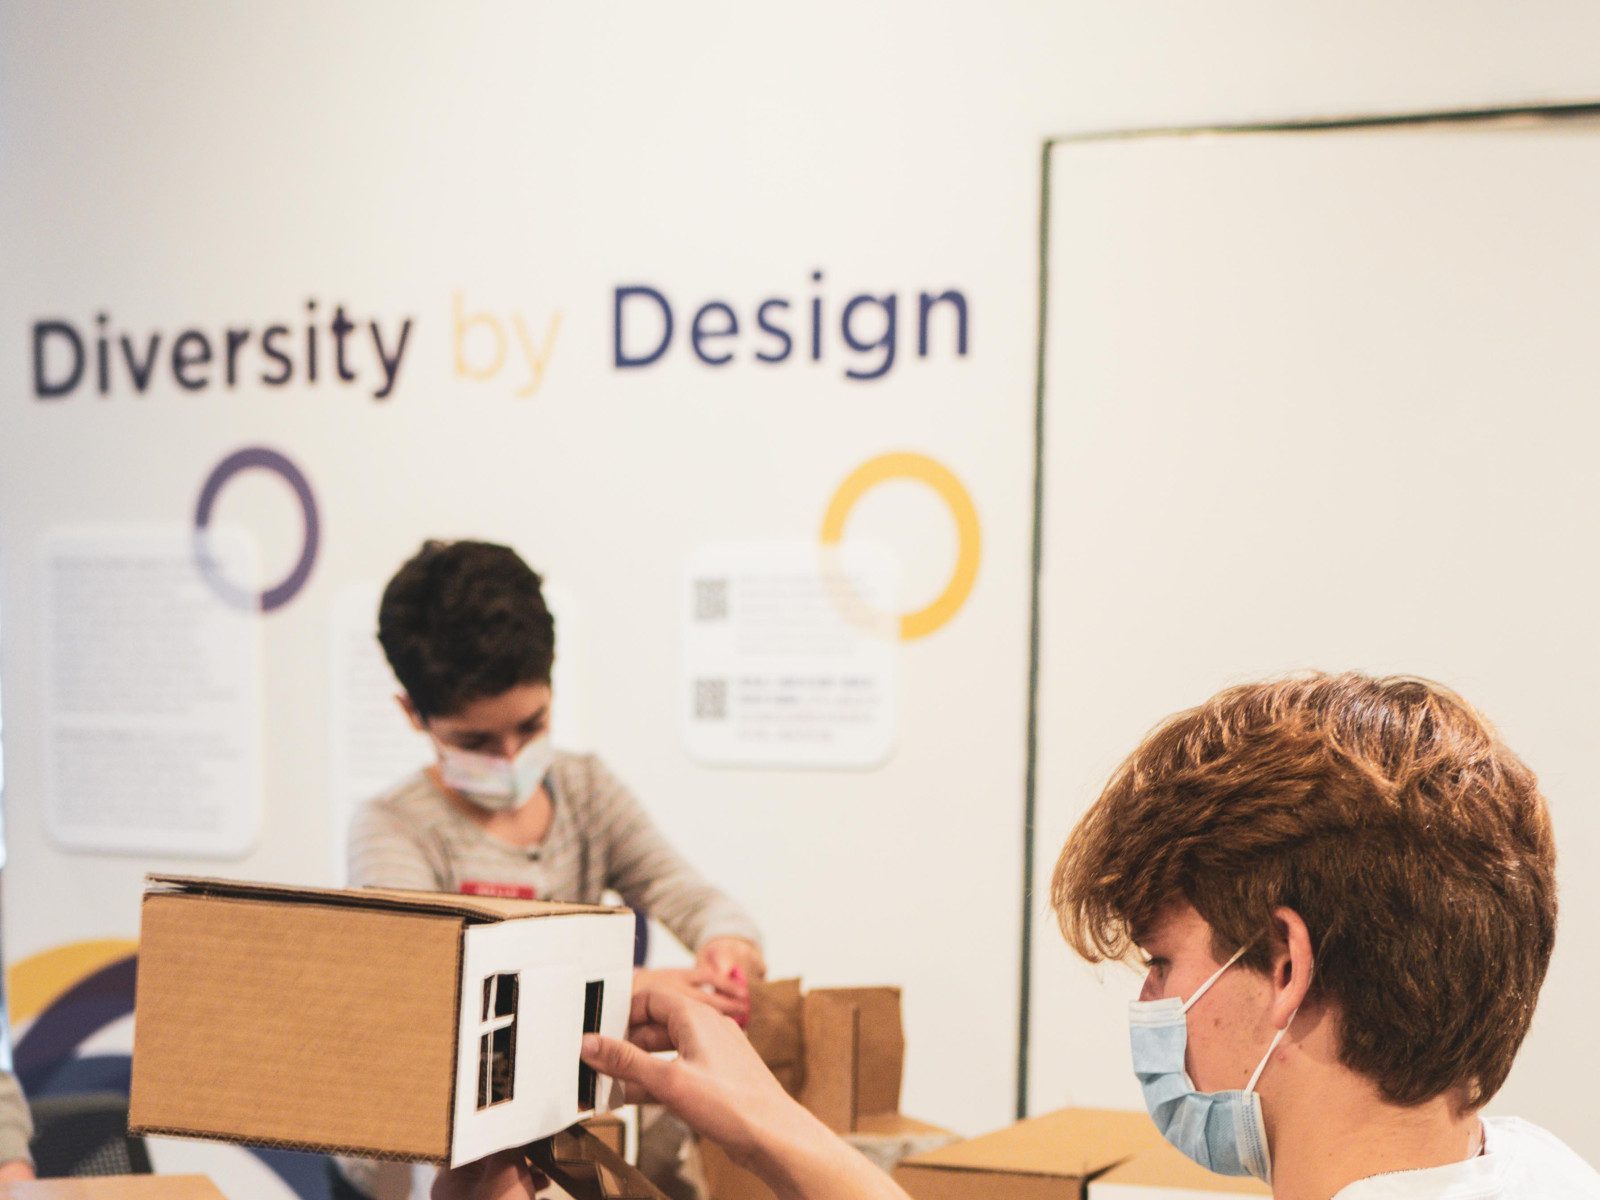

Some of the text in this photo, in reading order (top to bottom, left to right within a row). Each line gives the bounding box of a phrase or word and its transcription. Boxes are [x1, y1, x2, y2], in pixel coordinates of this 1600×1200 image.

[31, 270, 969, 401] Diversity by Design
